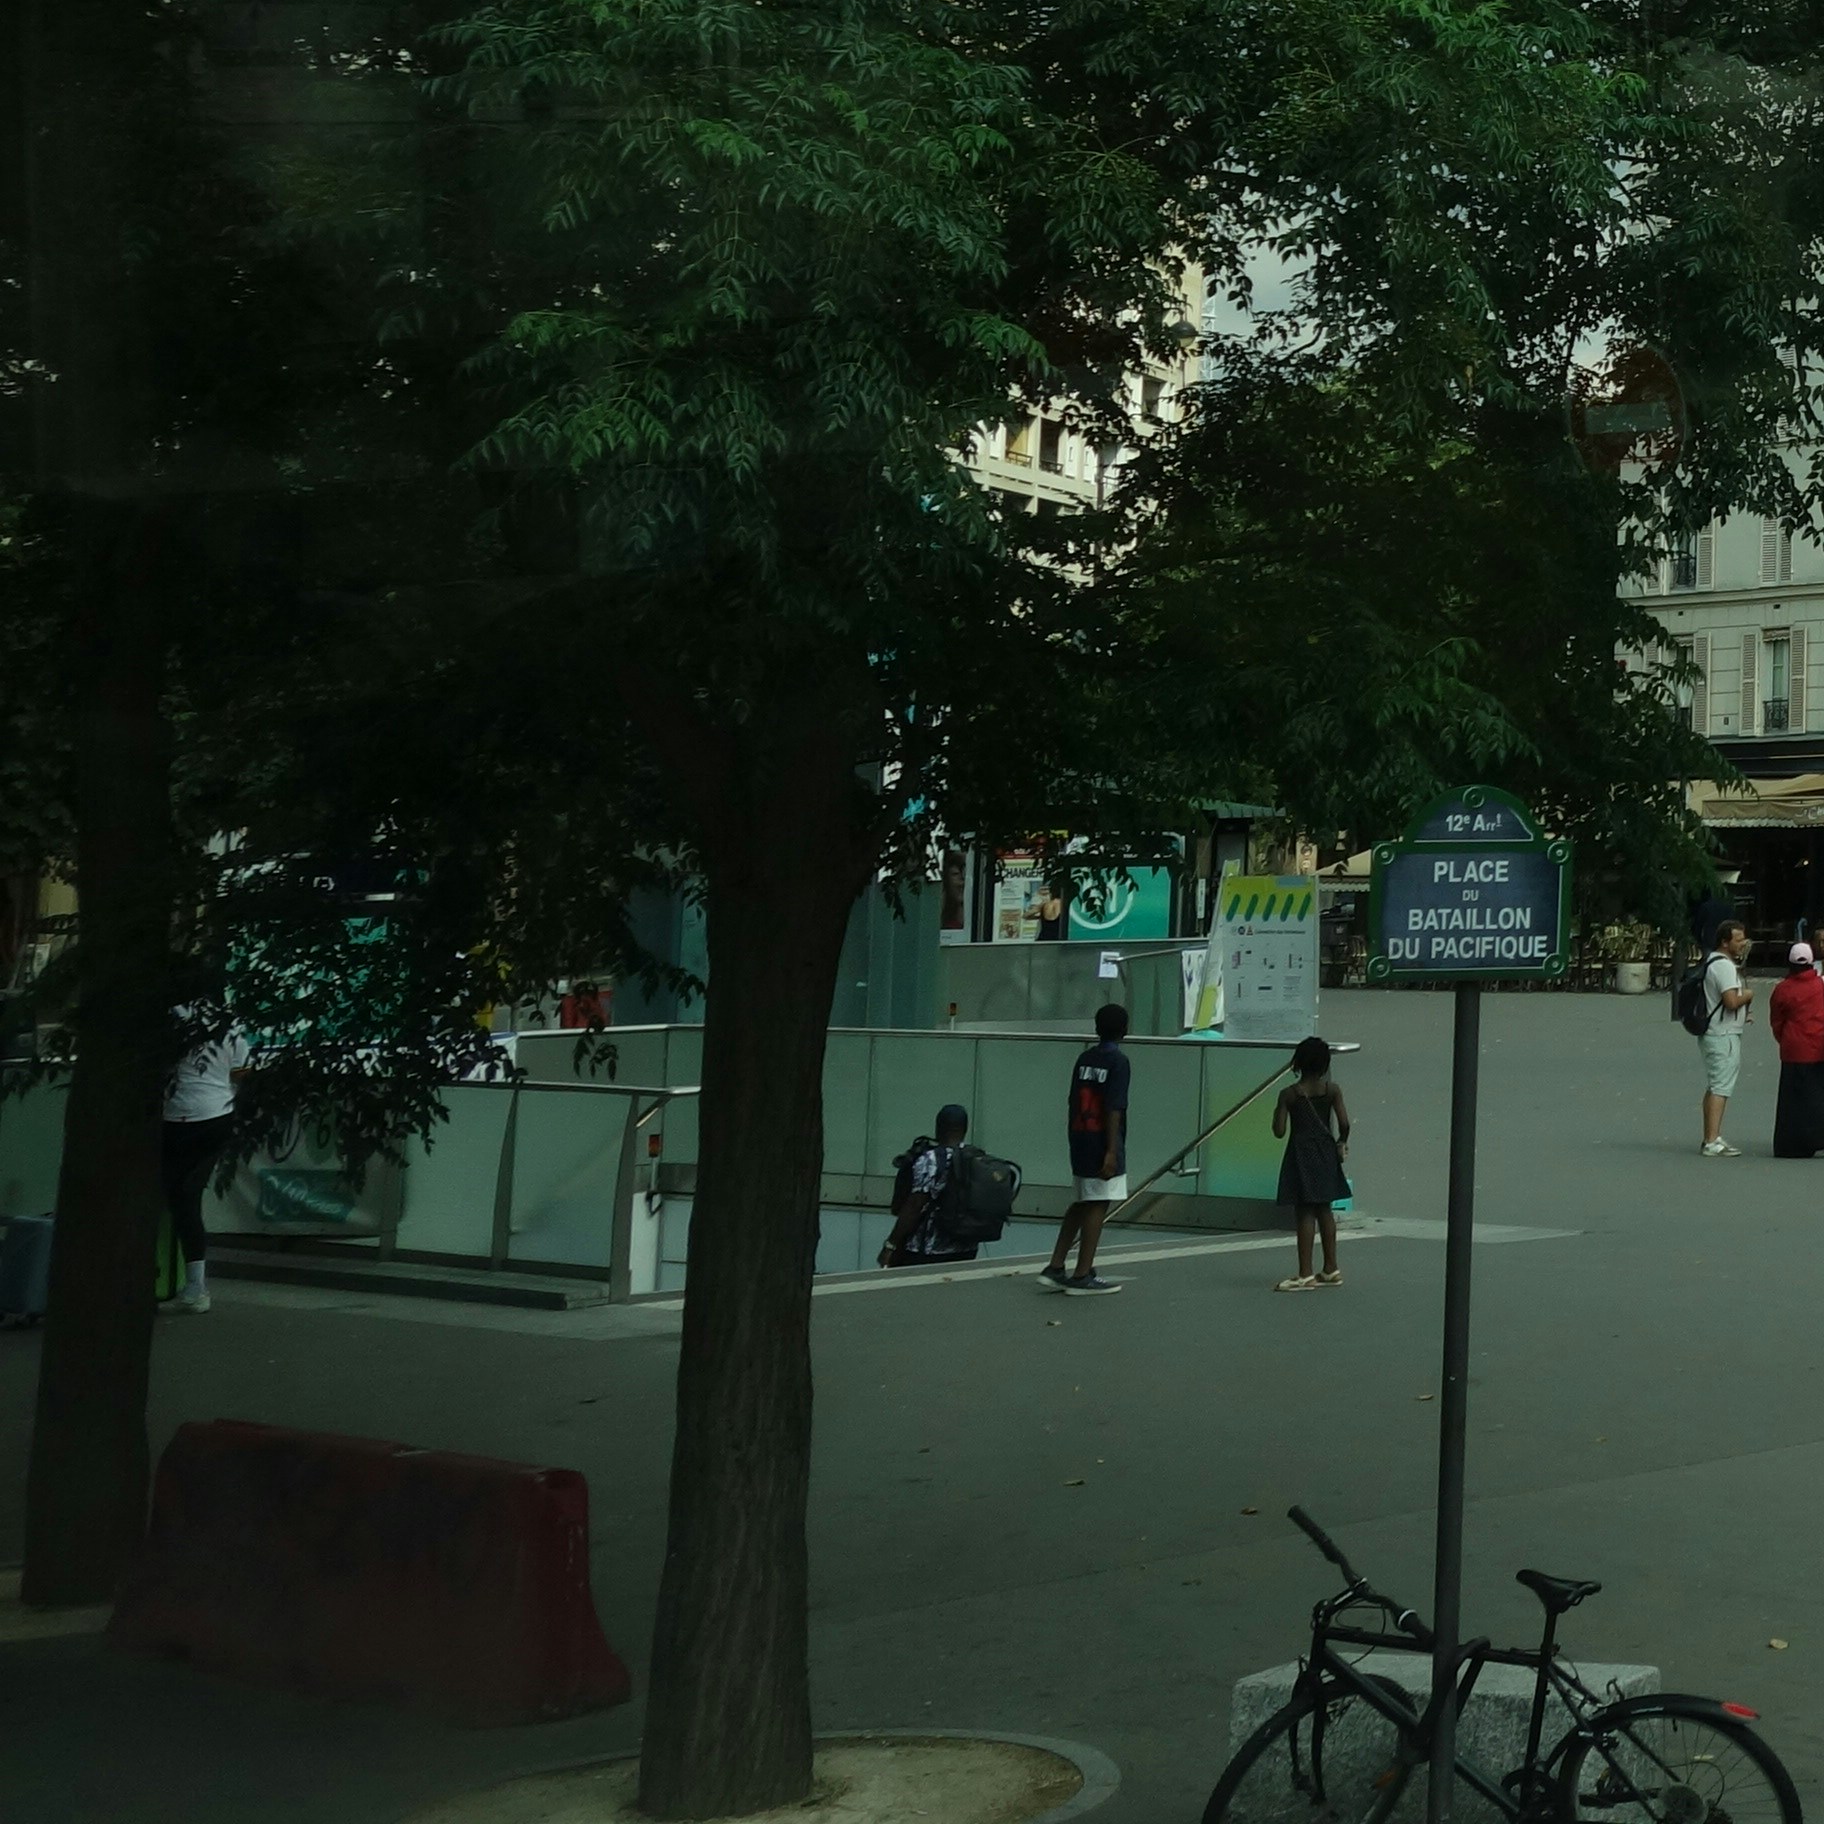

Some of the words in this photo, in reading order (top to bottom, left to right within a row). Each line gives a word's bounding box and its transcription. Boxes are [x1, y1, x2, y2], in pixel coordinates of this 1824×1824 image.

[1445, 815, 1470, 831] 12e
[1433, 860, 1510, 883] PLACE
[1462, 889, 1479, 902] DU
[1408, 907, 1532, 931] BATAILLON
[1388, 938, 1420, 960] DU
[1431, 935, 1548, 960] PACIFIQUE
